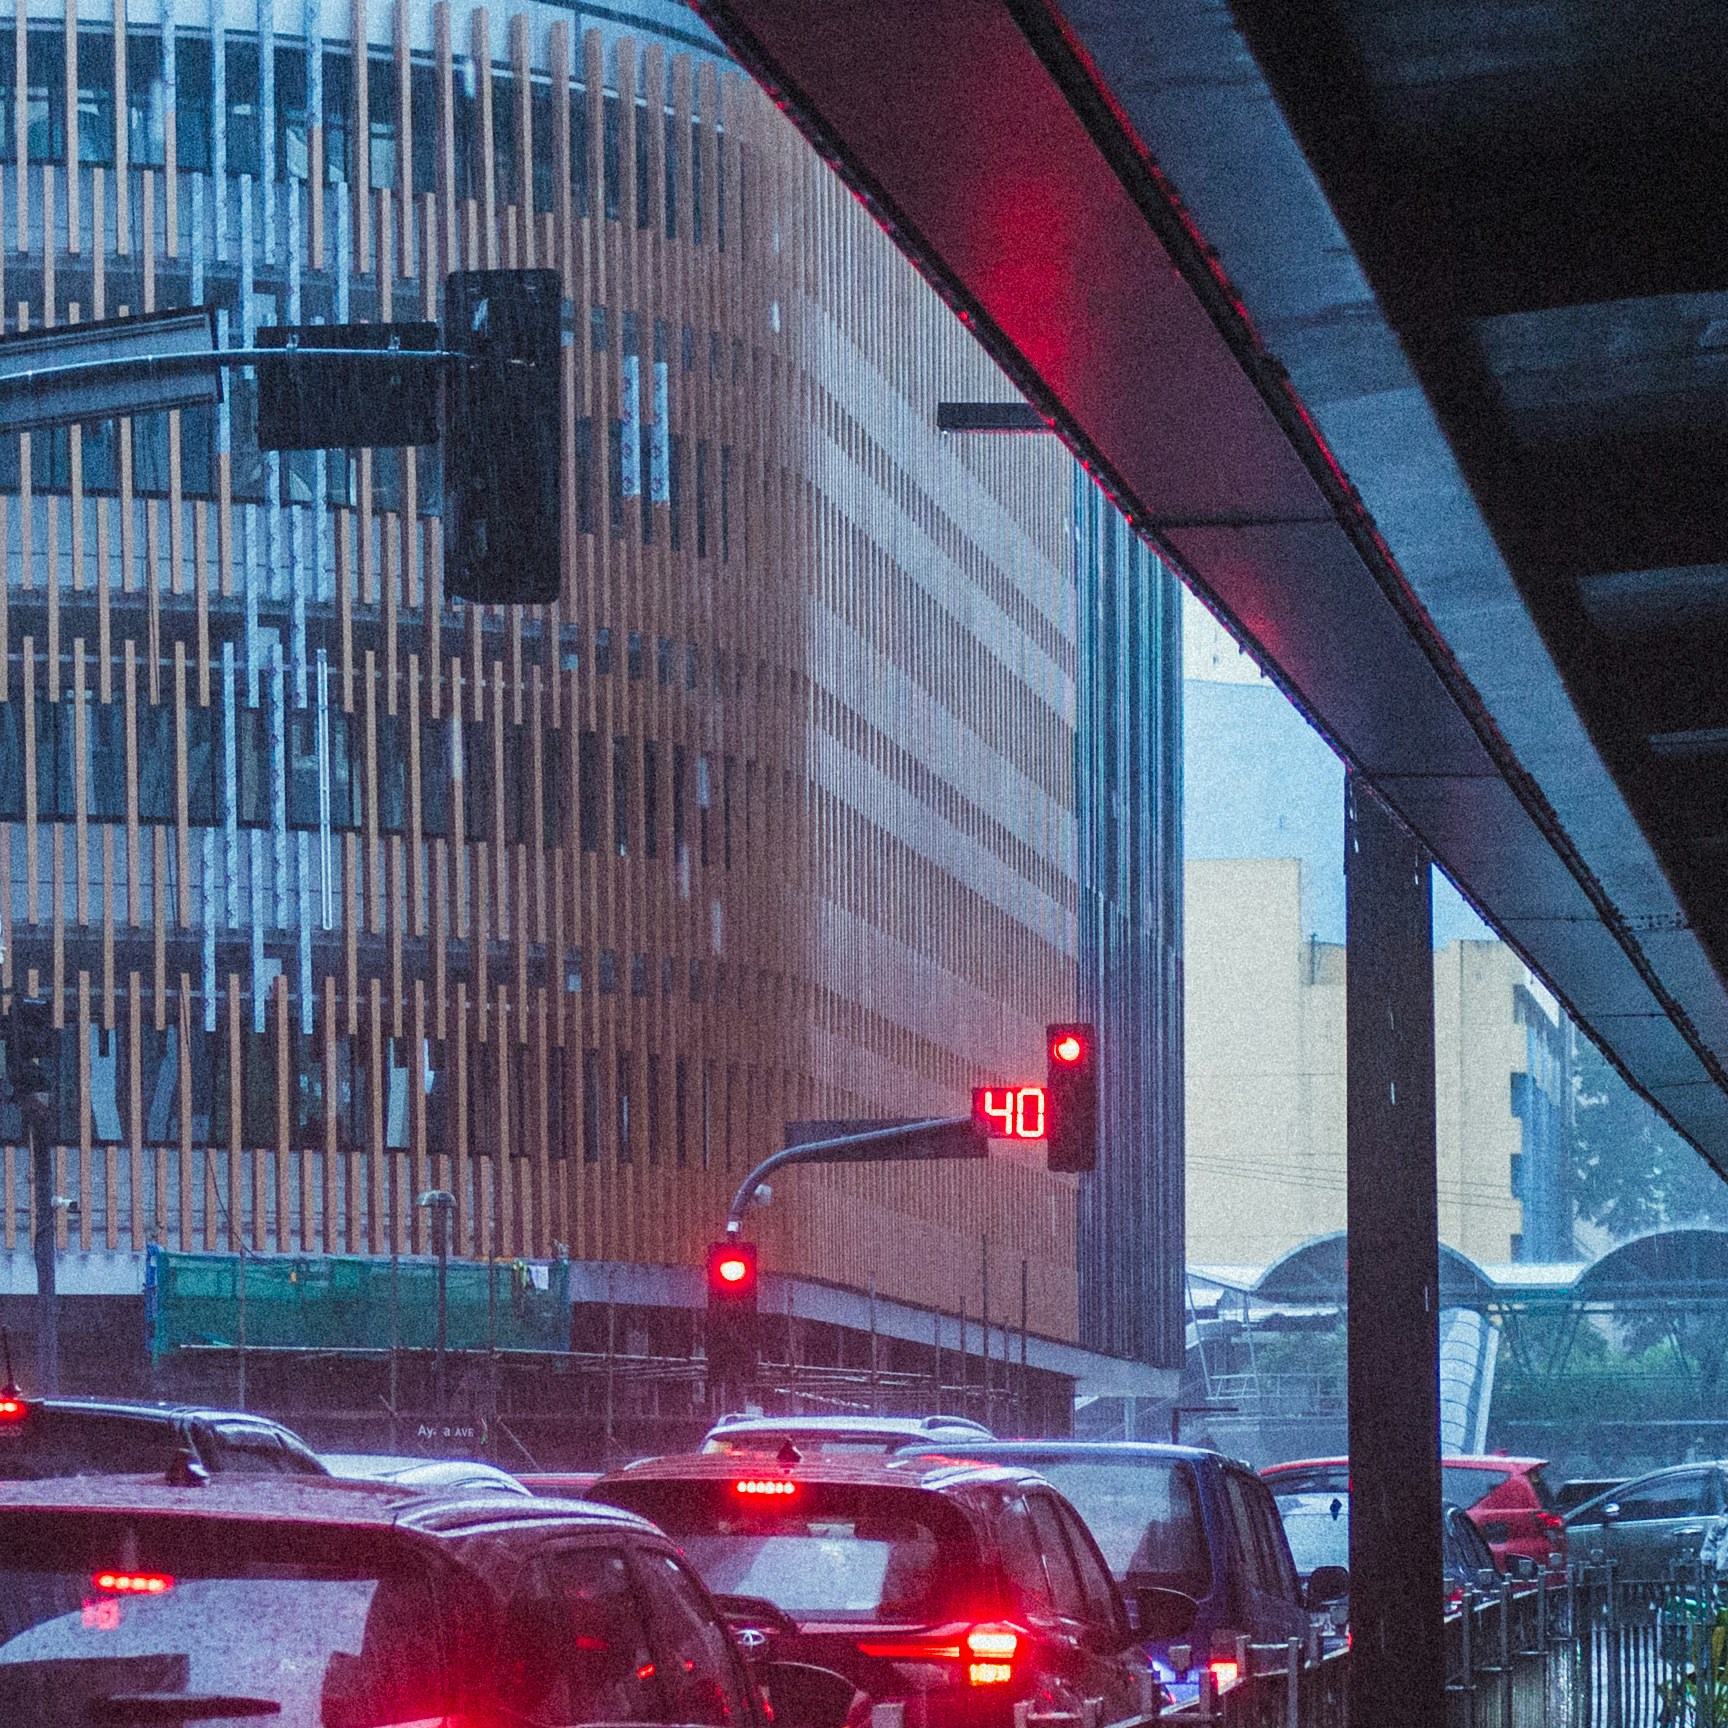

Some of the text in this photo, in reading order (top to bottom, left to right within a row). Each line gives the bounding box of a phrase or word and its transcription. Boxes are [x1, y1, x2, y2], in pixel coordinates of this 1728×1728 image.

[983, 1087, 1045, 1138] 40
[417, 1423, 475, 1439] Aya AVE
